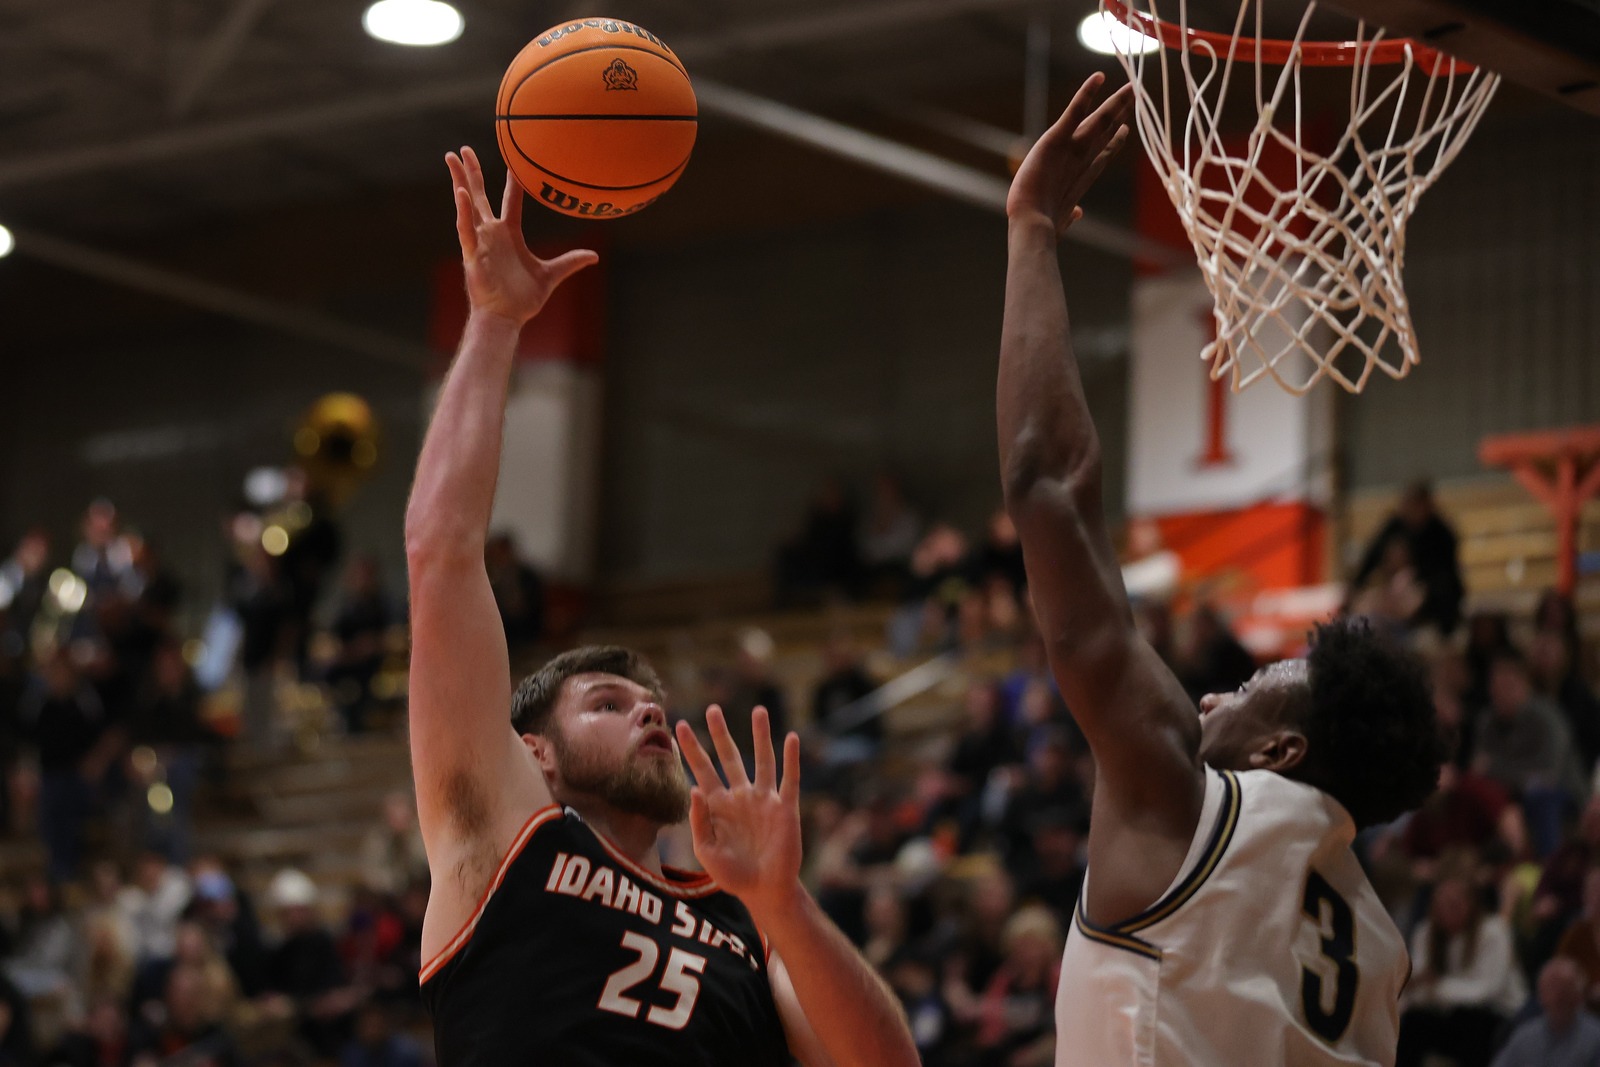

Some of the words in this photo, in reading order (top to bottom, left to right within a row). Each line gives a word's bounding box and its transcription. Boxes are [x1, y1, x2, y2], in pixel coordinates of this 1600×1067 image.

[539, 181, 661, 216] Wilso
[545, 852, 663, 925] IDAHO
[597, 930, 708, 1031] 25
[1302, 867, 1360, 1044] 3
